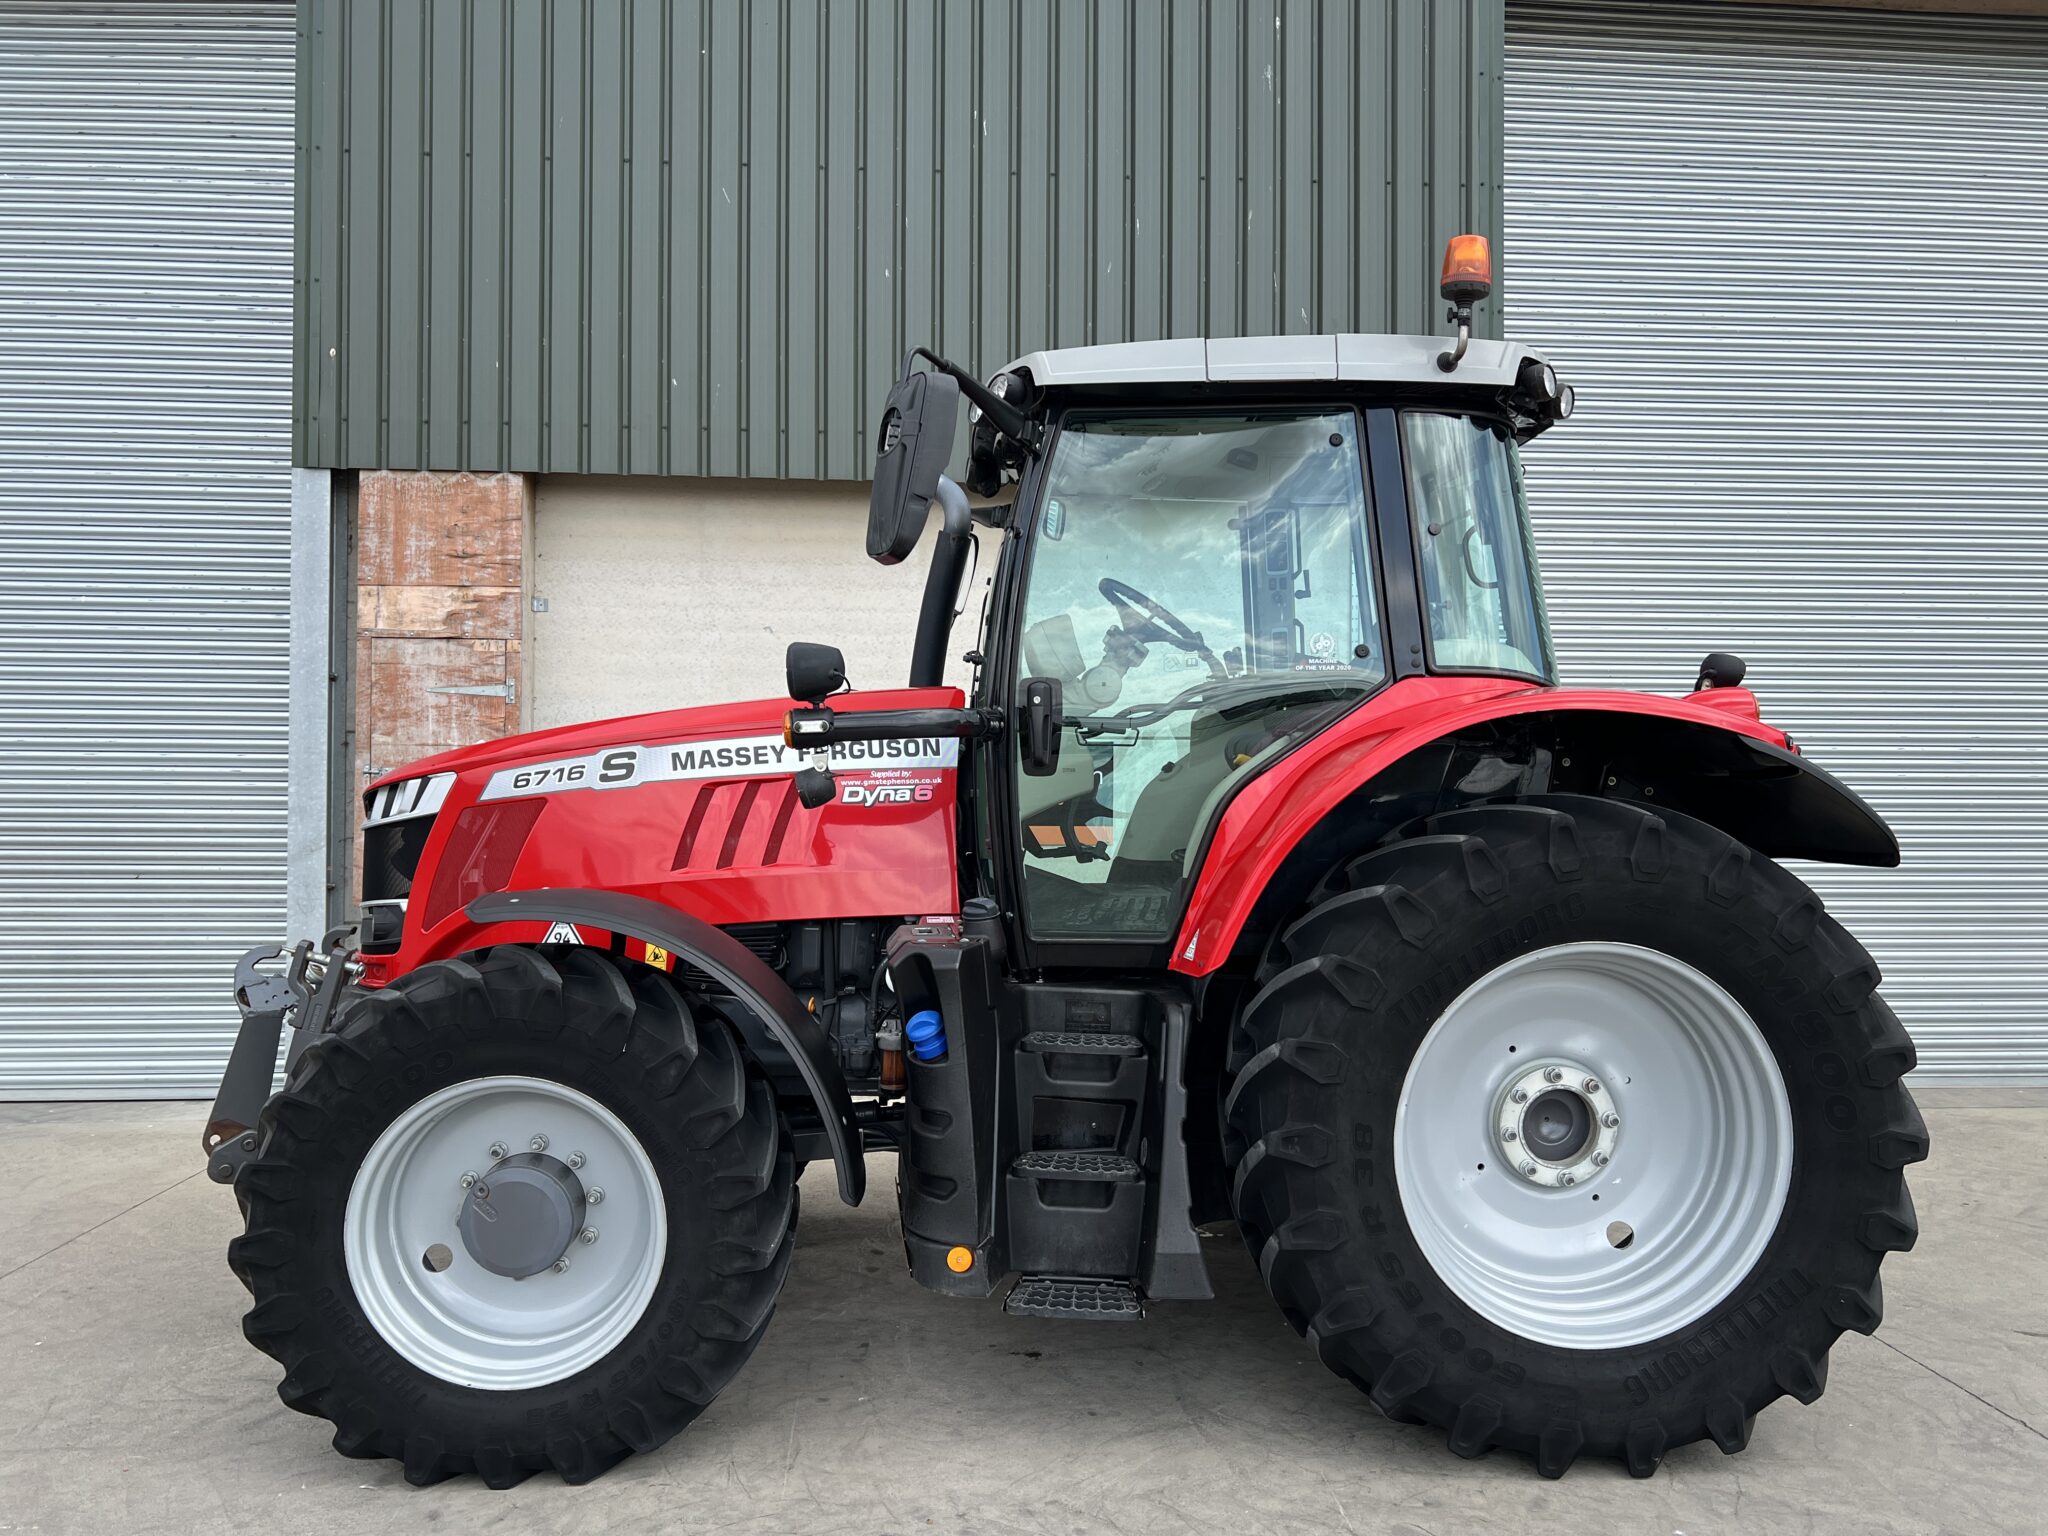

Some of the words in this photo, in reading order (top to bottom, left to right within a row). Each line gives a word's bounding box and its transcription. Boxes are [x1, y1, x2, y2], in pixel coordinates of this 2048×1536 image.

[513, 764, 586, 789] 6716
[599, 751, 637, 783] S
[671, 744, 786, 772] MASSEY
[798, 738, 941, 762] FRGUSON
[870, 769, 900, 779] Supplied
[901, 769, 912, 779] by:
[840, 777, 943, 787] www.gmstephenson.co.uk
[1622, 1267, 1820, 1407] TRELLEBORG
